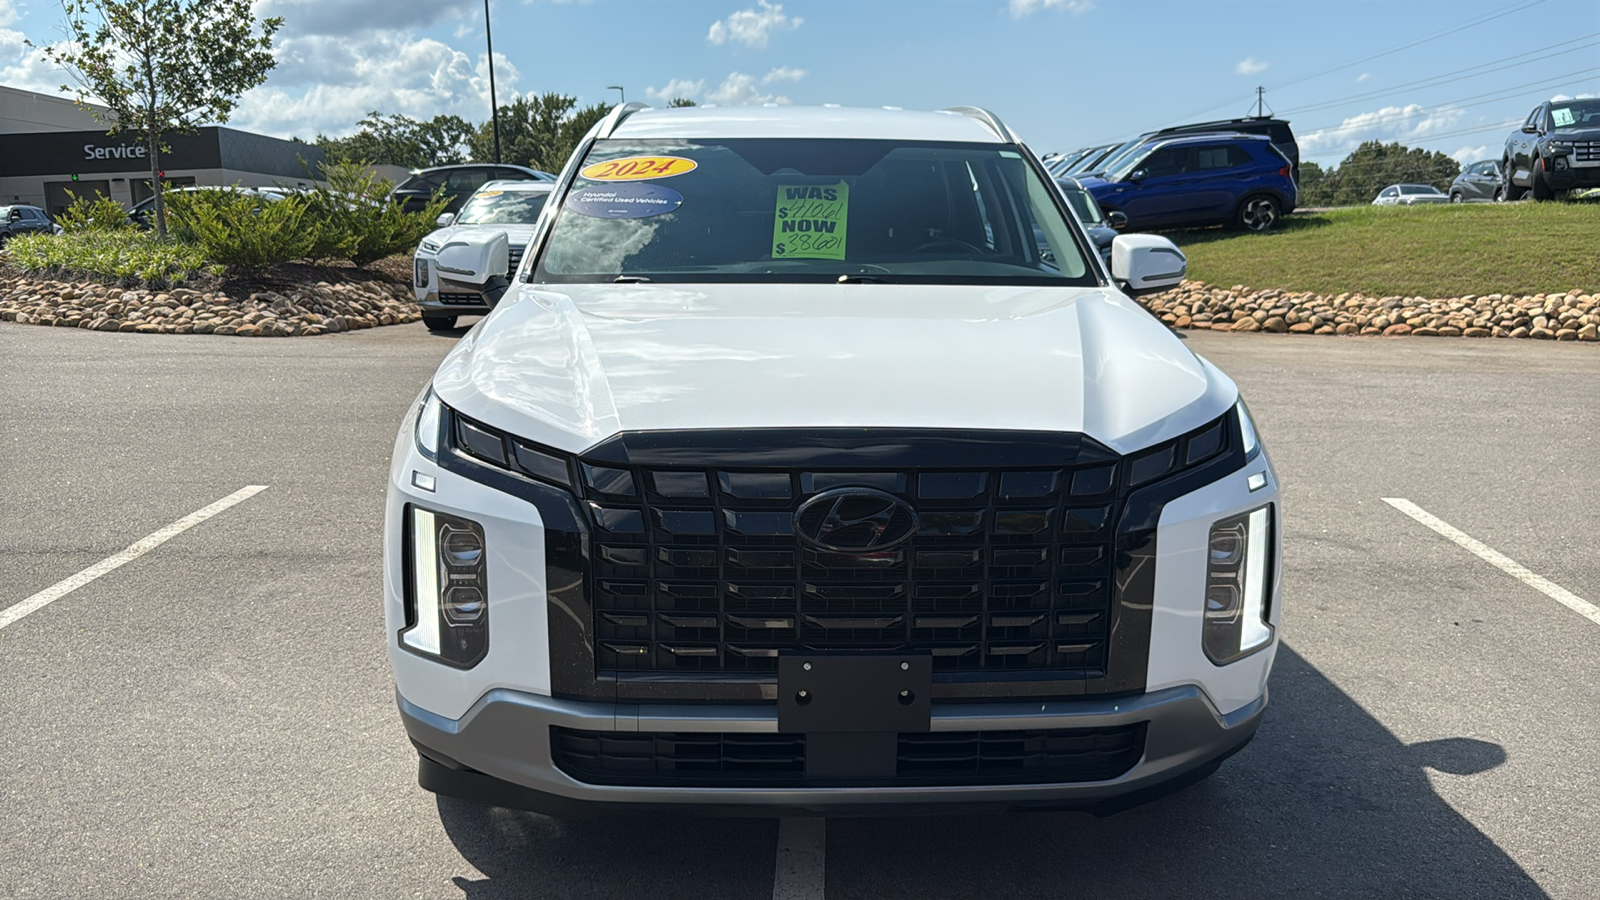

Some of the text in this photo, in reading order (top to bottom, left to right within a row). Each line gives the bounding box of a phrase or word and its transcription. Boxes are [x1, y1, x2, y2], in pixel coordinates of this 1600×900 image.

[84, 143, 145, 159] Service
[595, 159, 678, 178] 2024
[786, 187, 838, 201] WAS
[782, 219, 837, 233] NOW
